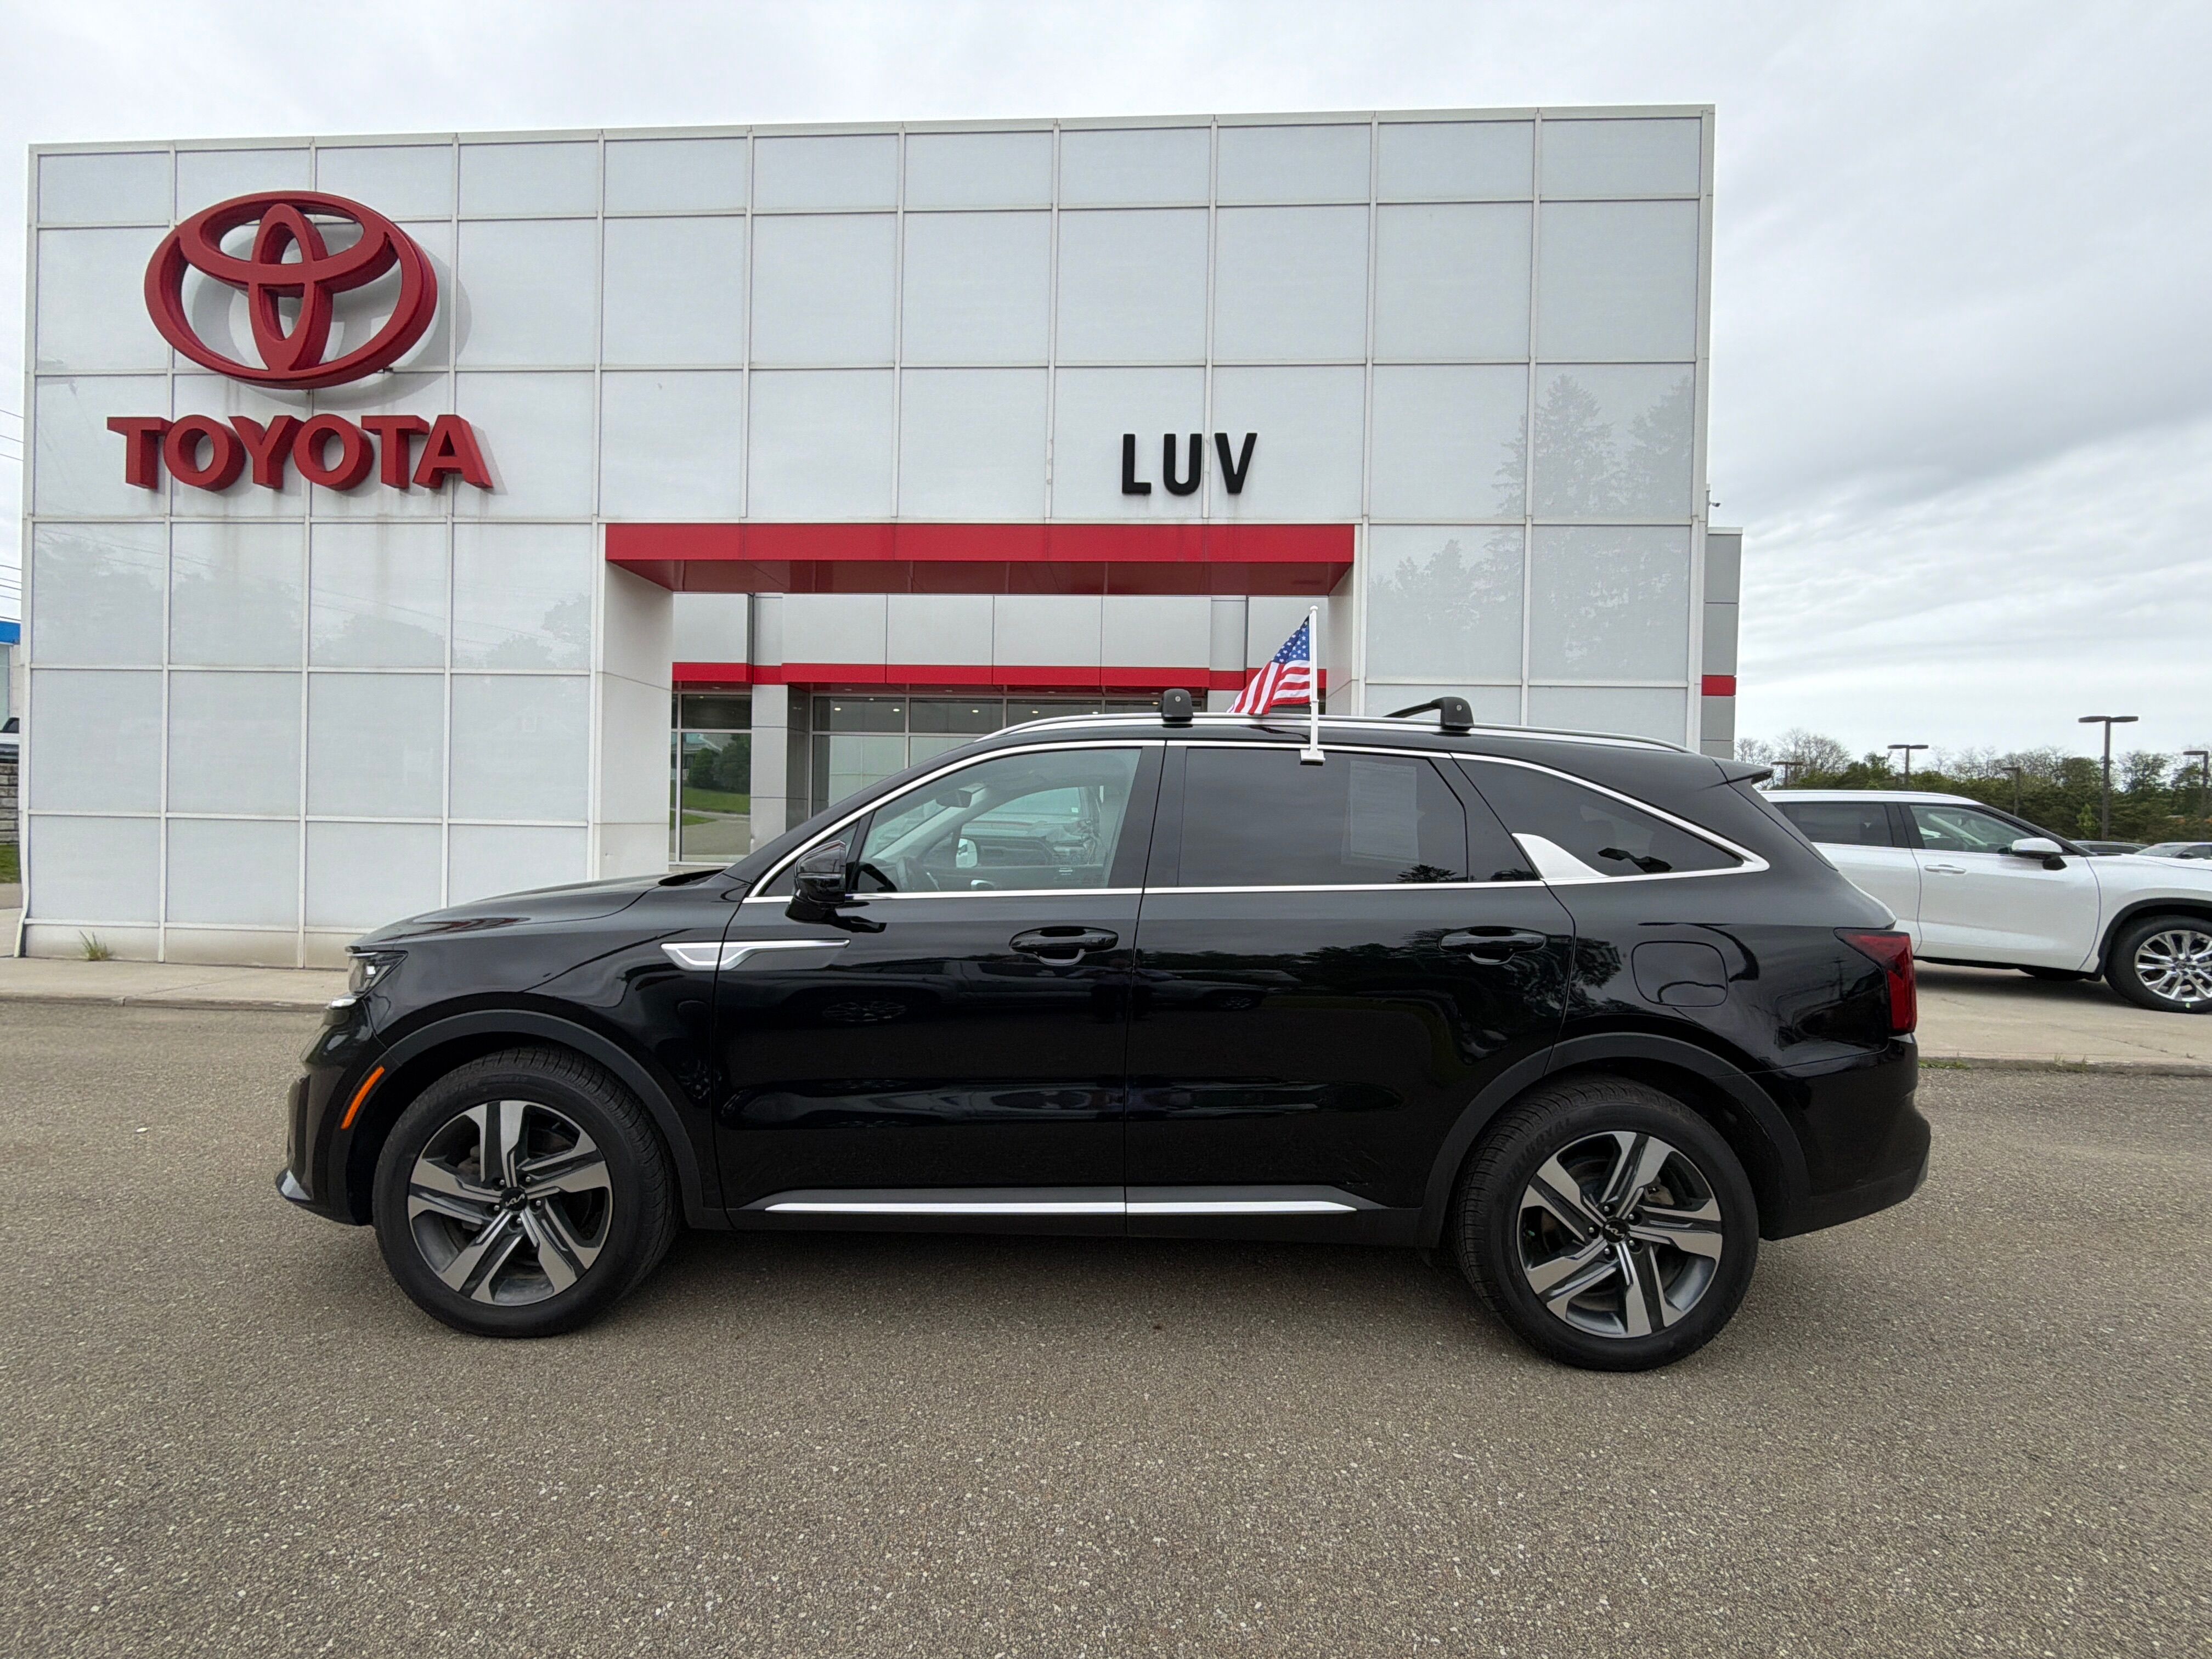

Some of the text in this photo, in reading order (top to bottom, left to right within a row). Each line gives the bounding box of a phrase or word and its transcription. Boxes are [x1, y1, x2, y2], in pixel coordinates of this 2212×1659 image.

[107, 414, 493, 491] TOYOTA
[1121, 432, 1258, 496] LUV
[1504, 1116, 1571, 1184] IROYAL
